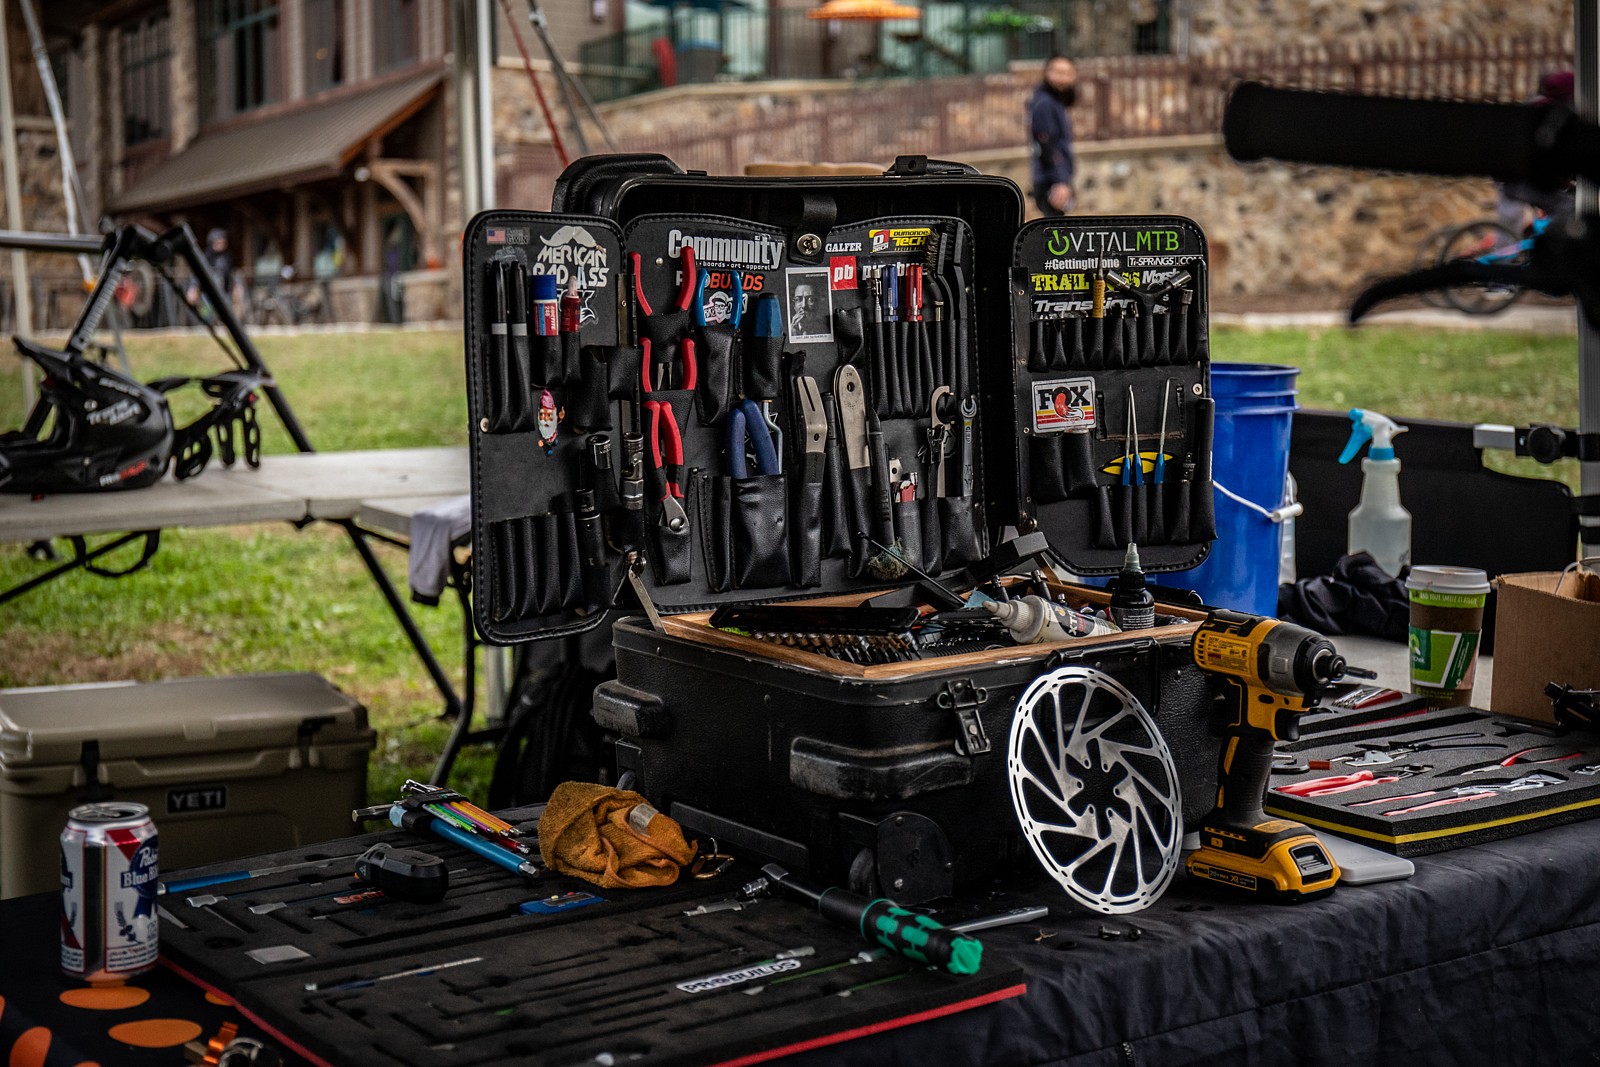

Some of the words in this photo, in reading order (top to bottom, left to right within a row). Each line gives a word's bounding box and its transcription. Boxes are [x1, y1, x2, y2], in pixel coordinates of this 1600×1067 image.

[825, 242, 862, 252] GALFER
[834, 265, 854, 282] pb
[1031, 273, 1090, 291] TRAIL
[1034, 297, 1136, 313] Transion
[1038, 386, 1091, 411] FOX
[172, 790, 221, 809] YETI
[123, 871, 149, 887] Blue
